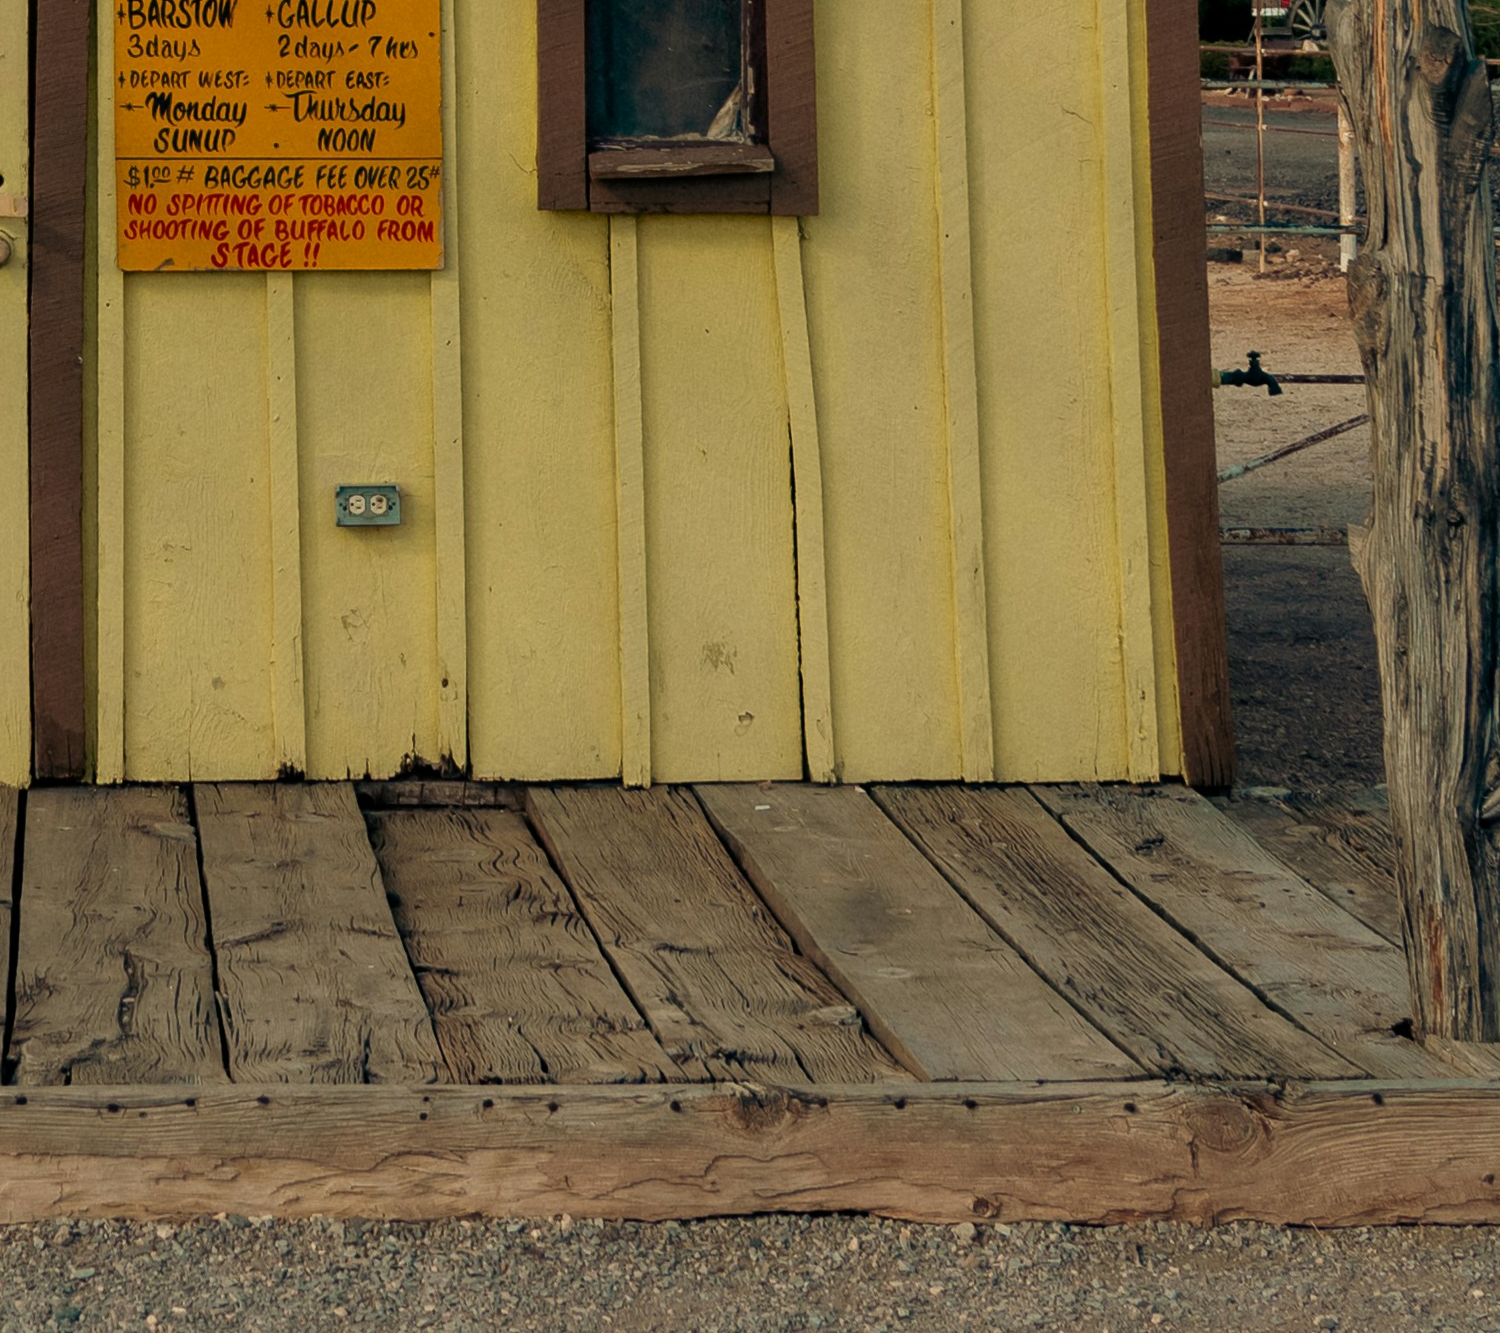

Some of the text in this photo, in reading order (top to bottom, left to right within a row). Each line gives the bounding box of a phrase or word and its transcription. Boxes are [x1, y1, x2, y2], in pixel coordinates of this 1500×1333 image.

[130, 70, 191, 89] DEPART
[276, 70, 336, 89] DEPART
[145, 91, 247, 128] Monday
[281, 90, 406, 130] Thursday
[154, 127, 236, 153] SUNUP
[317, 127, 376, 152] NOON
[204, 165, 304, 189] BAGGAGE
[315, 165, 348, 189] FEE
[354, 165, 401, 190] OVER
[128, 193, 424, 218] NO SPITTING OF TOBACCO OR
[124, 218, 434, 243] SHOOTING OF BUFFALO FROM
[211, 241, 292, 269] STAGE
